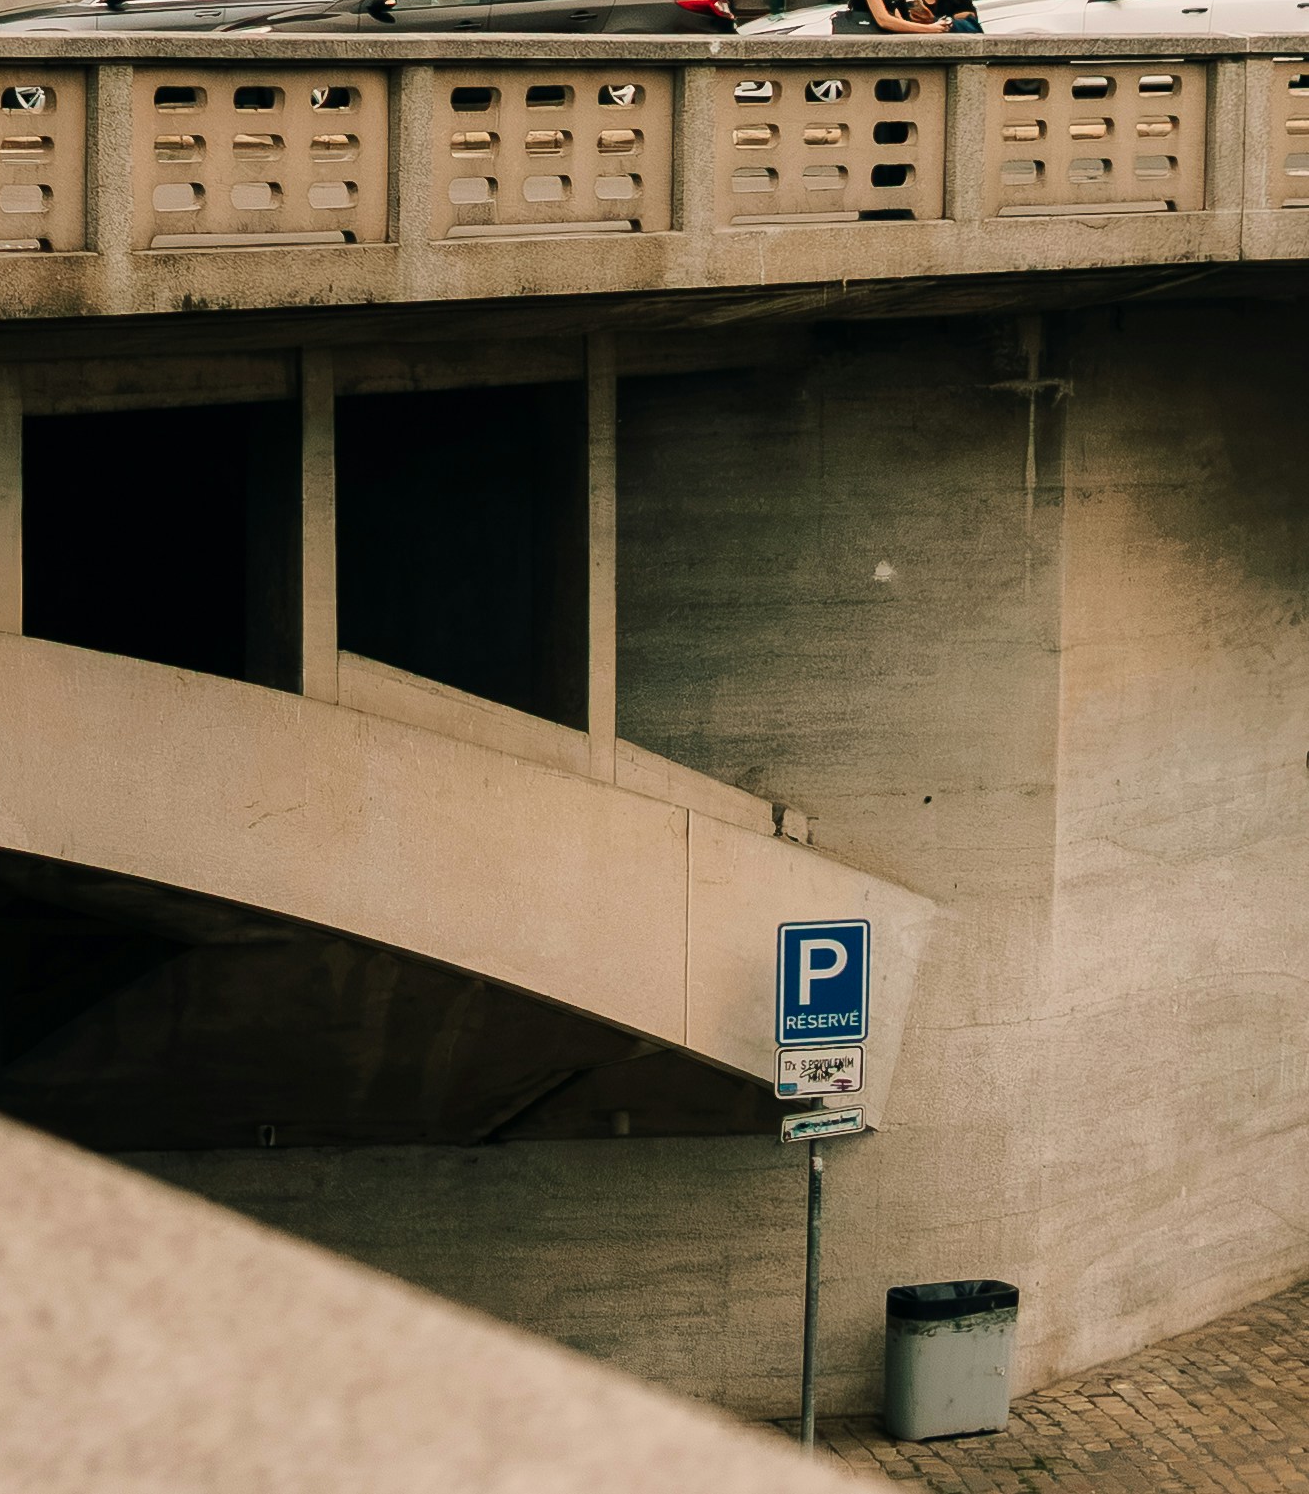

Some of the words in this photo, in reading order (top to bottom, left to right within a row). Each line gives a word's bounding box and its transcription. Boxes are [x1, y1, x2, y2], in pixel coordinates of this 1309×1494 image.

[799, 938, 848, 1005] P
[786, 1010, 860, 1030] RÉSERVÉ
[800, 1059, 808, 1070] S
